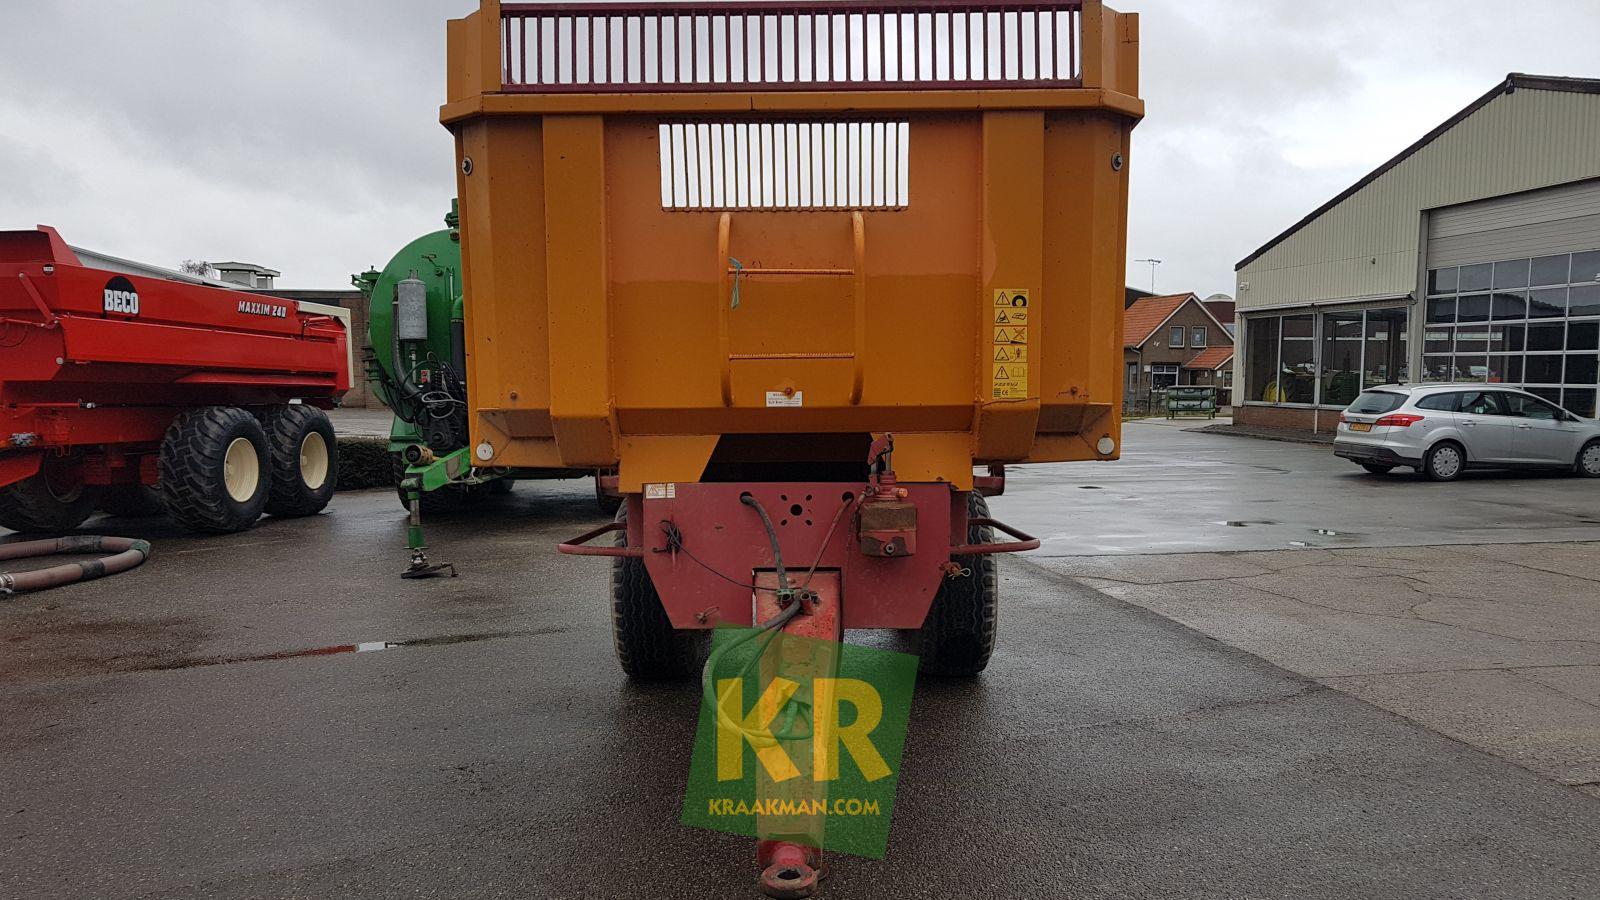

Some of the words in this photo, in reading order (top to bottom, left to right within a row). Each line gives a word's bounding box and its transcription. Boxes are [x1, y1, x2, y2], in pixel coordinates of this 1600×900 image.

[104, 289, 139, 315] BECO
[238, 301, 270, 316] MAXXIM
[272, 305, 287, 318] 240
